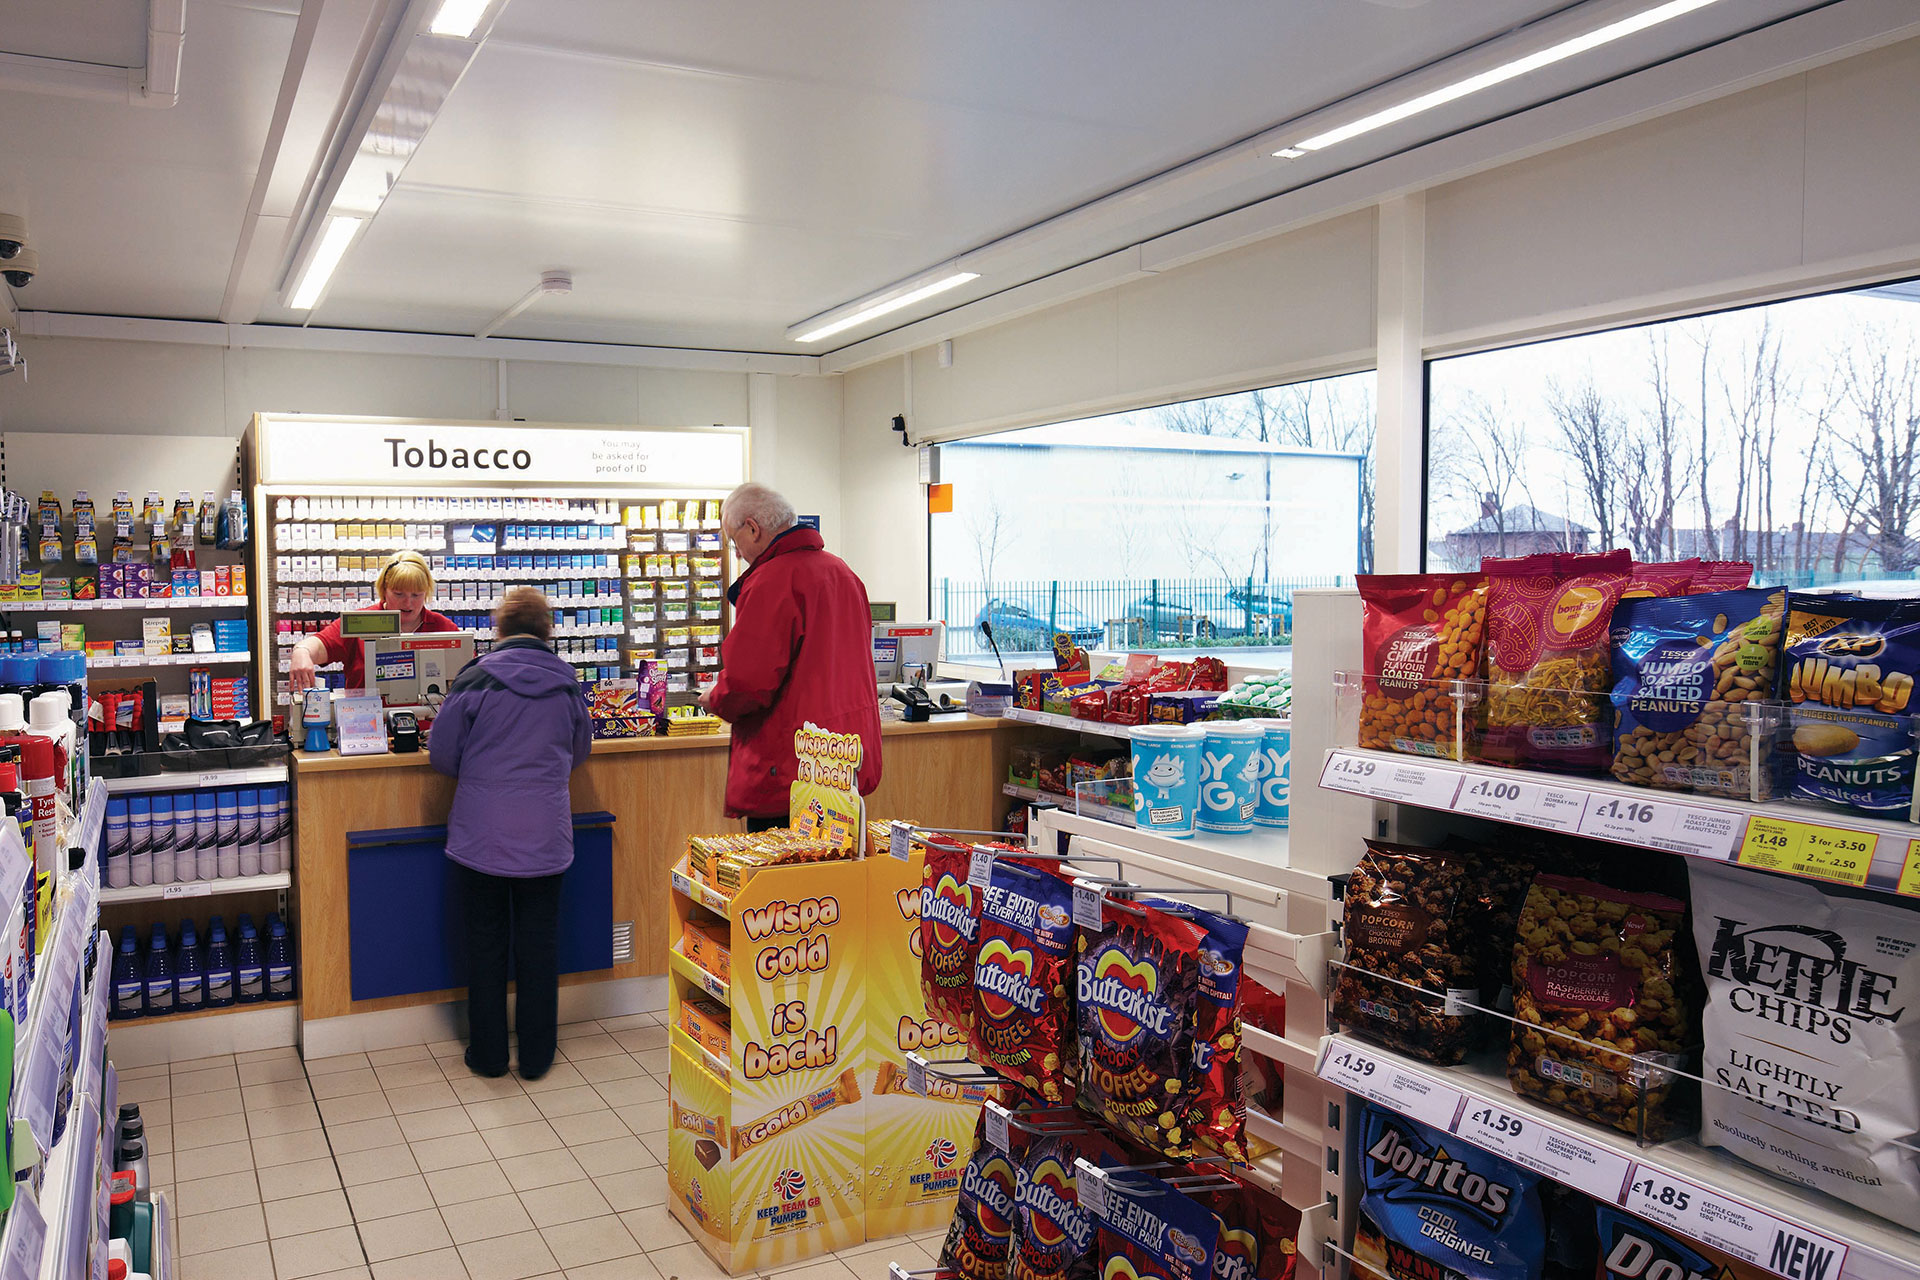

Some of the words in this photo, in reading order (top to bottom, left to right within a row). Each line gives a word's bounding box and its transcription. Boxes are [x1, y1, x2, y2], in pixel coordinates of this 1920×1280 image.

[384, 438, 532, 469] Tobacco
[601, 440, 619, 448] You
[621, 441, 641, 450] may
[592, 451, 603, 460] be
[606, 452, 634, 460] asked
[636, 452, 649, 461] for
[596, 464, 623, 474] proof
[625, 464, 635, 472] of
[1802, 618, 1819, 631] BEST
[1820, 619, 1837, 632] NUTS
[1390, 640, 1432, 652] SWEET
[1383, 660, 1426, 672] FLAVOUR
[1386, 650, 1428, 664] CHILLI
[1382, 669, 1423, 680] COATED
[1639, 661, 1707, 675] JUMBO
[1379, 678, 1419, 690] PEANUTS
[1640, 674, 1704, 688] ROASTED
[1789, 657, 1914, 714] JUMBO
[1633, 686, 1703, 700] SALTED
[1630, 700, 1700, 713] PEANUTS
[1802, 710, 1838, 721] BIGGEST
[1858, 717, 1899, 729] PEANUTS!
[796, 733, 828, 758] Wispa
[828, 737, 858, 762] Gold
[800, 761, 811, 782] is
[814, 760, 851, 791] back!
[1333, 759, 1376, 776] £1.39
[1797, 756, 1901, 785] PEANUTS
[1470, 780, 1520, 800] £1.00
[1820, 786, 1873, 803] salted
[1596, 800, 1654, 823] £1.16
[1708, 817, 1731, 825] JUMBO
[1683, 824, 1712, 833] PEANUTS
[1685, 819, 1707, 827] ROAST
[1707, 823, 1731, 831] SALTED
[1752, 833, 1788, 847] £1.48
[1808, 835, 1817, 844] 3
[1818, 838, 1832, 847] for
[1834, 839, 1866, 852] £3.50
[1806, 854, 1813, 862] 2
[1829, 858, 1856, 869] £2.50
[921, 887, 980, 941] Butterkist
[989, 903, 1015, 921] EVERY
[1006, 892, 1039, 918] ENTRY
[742, 896, 840, 941] Wispa
[1361, 914, 1415, 930] POPCORN
[1625, 921, 1645, 930] New!
[1368, 930, 1404, 939] CHOCOLATE
[1368, 936, 1402, 947] BROWNIE
[1892, 939, 1917, 948] BEFORE
[756, 933, 830, 980] Gold
[929, 944, 967, 974] TOFFEE
[1546, 966, 1616, 983] POPCORN
[1707, 915, 1906, 1025] KETTLE
[935, 972, 969, 989] POPCORN
[974, 963, 1045, 1012] utterkist
[1547, 981, 1602, 996] RASPBERRY
[1077, 964, 1173, 1036] Butterkist
[1546, 989, 1566, 999] MILK
[1566, 993, 1610, 1003] CHOCOLATE
[772, 1000, 806, 1036] is
[1729, 987, 1852, 1045] CHIPS
[979, 1016, 1032, 1049] TOFFEE
[744, 1025, 837, 1079] back!
[990, 1048, 1032, 1067] POPCORN
[1094, 1039, 1140, 1066] SPOOKY
[1334, 1053, 1376, 1076] £1.59
[1090, 1057, 1160, 1100] TOFFEE
[1395, 1074, 1410, 1083] TESCO
[1409, 1079, 1431, 1092] POPCORN
[1729, 1048, 1844, 1102] LIGHTLY
[1407, 1084, 1427, 1095] BROWNIE
[1105, 1098, 1158, 1118] POPCORN
[1716, 1067, 1862, 1134] SALTED
[681, 1111, 703, 1134] Gold
[748, 1100, 807, 1144] Gold
[1471, 1108, 1523, 1137] £1.59
[1545, 1146, 1560, 1156] CHOC
[1560, 1152, 1573, 1161] 150G
[1546, 1141, 1578, 1158] RASPBERRY
[1582, 1155, 1597, 1165] MILK
[1548, 1135, 1566, 1146] TESCO
[1566, 1141, 1592, 1157] POPCORN
[1713, 1118, 1767, 1149] absolutely
[1770, 1143, 1819, 1171] nothing
[1822, 1162, 1883, 1187] artificial
[910, 1173, 932, 1184] KEEP
[933, 1168, 957, 1180] TEAM
[1368, 1128, 1513, 1214] Doritos
[923, 1178, 959, 1192] PUMPED
[964, 1160, 1015, 1221] Butter
[1631, 1179, 1691, 1211] £1.85
[757, 1206, 779, 1220] KEEP
[781, 1199, 805, 1213] TEAM
[808, 1196, 821, 1208] GB
[1014, 1167, 1092, 1248] Butterkist
[1127, 1200, 1169, 1235] ENTRY
[1644, 1202, 1657, 1212] £1.24
[1657, 1208, 1666, 1216] per
[1665, 1212, 1678, 1221] 100g
[1699, 1212, 1714, 1222] 150G
[1702, 1201, 1727, 1214] KETTLE
[1726, 1210, 1746, 1222] CHIPS
[770, 1209, 807, 1227] PUMPED
[1418, 1205, 1460, 1234] COOL
[1700, 1206, 1728, 1221] LIGHTLY
[1727, 1217, 1753, 1232] SALTED
[1111, 1215, 1139, 1239] EVERY
[1138, 1228, 1163, 1252] PACK!
[1020, 1240, 1062, 1269] SPOOKY
[1389, 1244, 1440, 1280] WIN
[1769, 1229, 1834, 1280] NEW
